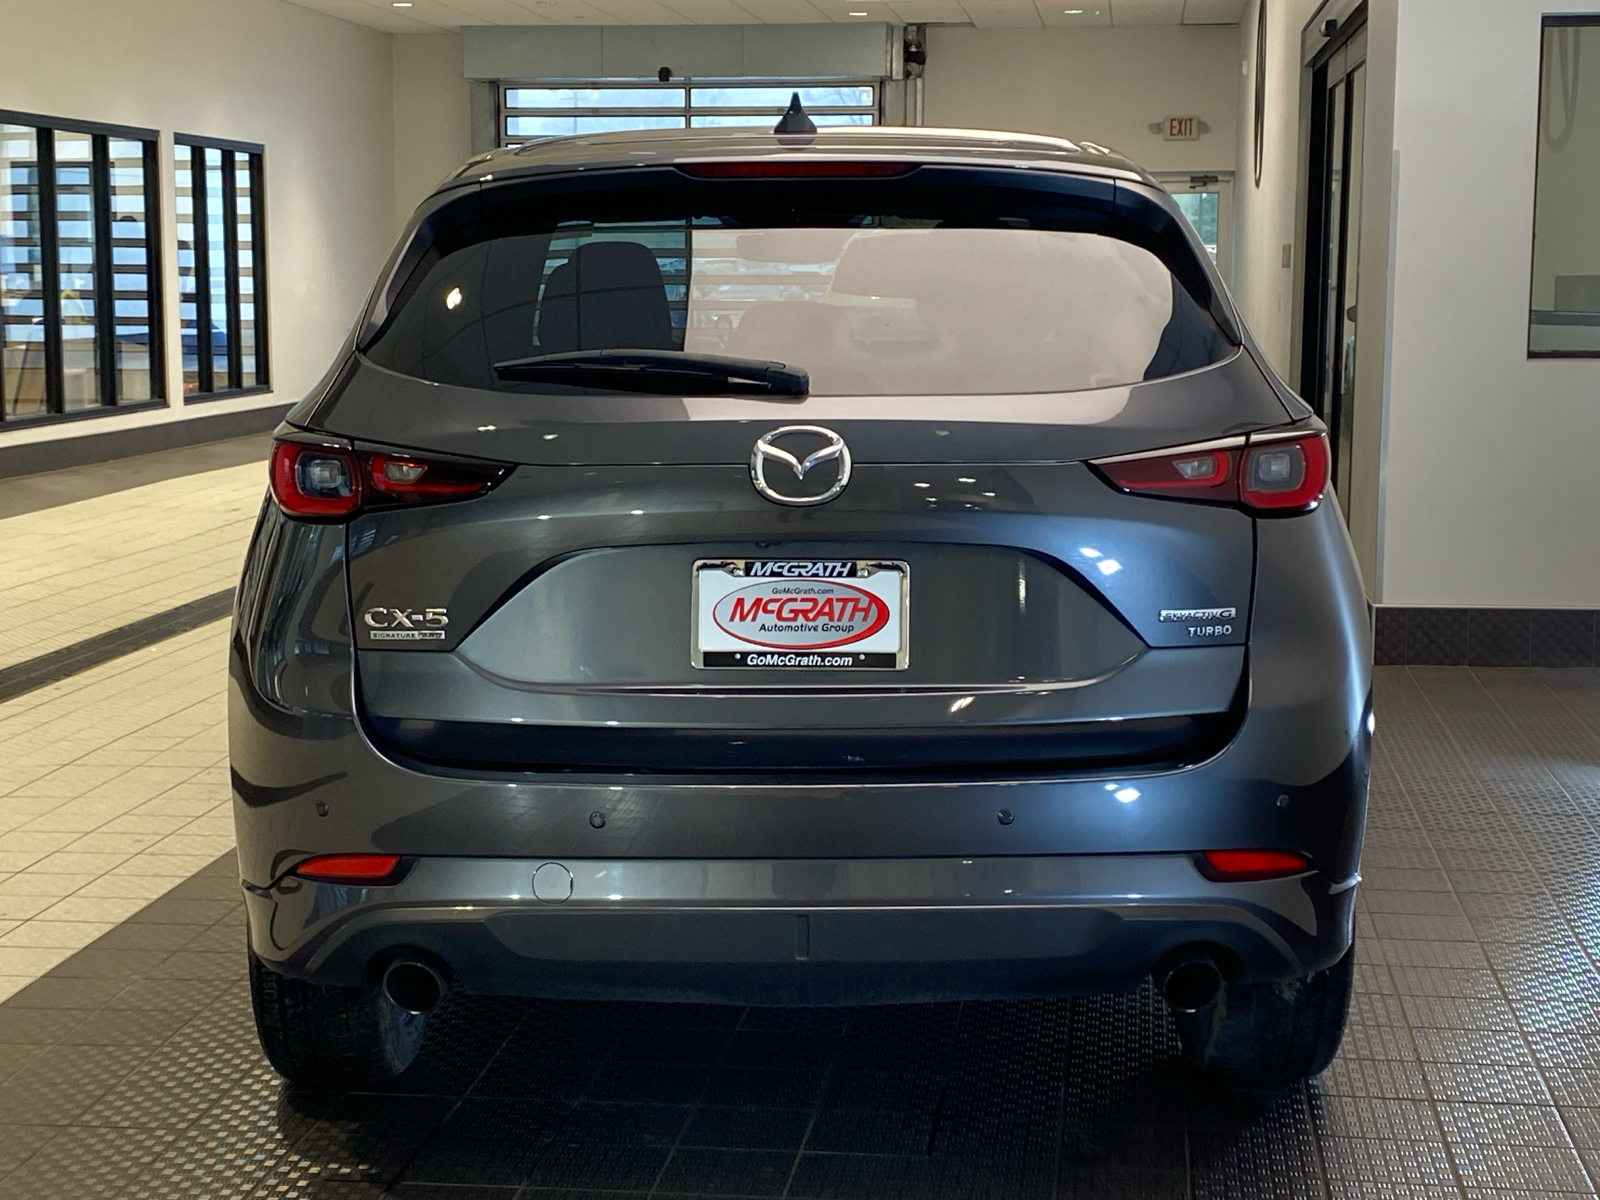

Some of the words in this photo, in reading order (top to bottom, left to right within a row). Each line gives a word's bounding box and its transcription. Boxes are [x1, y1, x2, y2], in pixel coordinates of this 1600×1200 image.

[1170, 117, 1194, 136] EXIT
[771, 587, 834, 595] GoMcGrath.com
[364, 607, 449, 628] CX-5
[758, 623, 819, 632] Automotive
[821, 623, 855, 634] Group
[1188, 624, 1232, 637] TURBO
[747, 654, 853, 666] GoMcGrath.com
